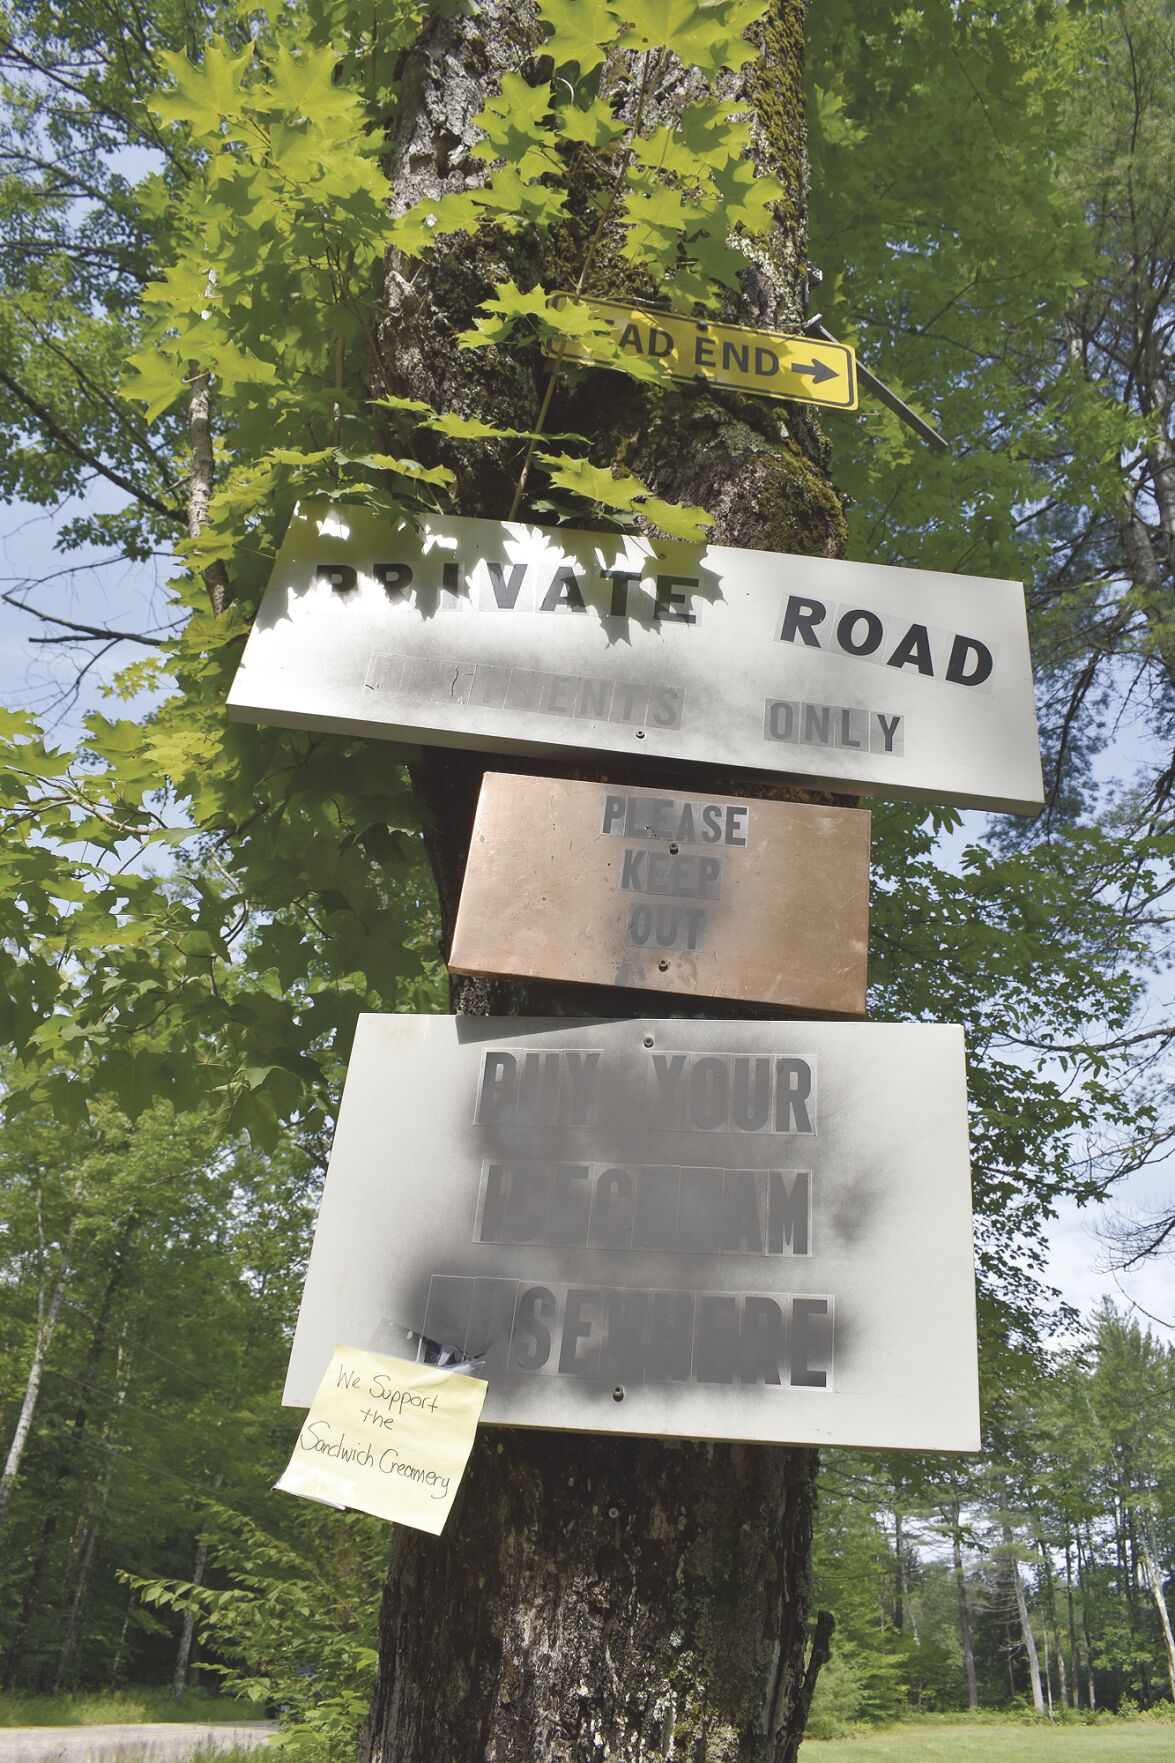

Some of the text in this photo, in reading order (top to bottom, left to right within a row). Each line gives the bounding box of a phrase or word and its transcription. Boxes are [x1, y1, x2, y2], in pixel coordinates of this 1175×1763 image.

[695, 336, 780, 376] END
[780, 595, 993, 687] ROAD
[769, 702, 901, 752] ONLY
[602, 795, 748, 846] PLEASE
[621, 850, 720, 900] KEEP
[630, 904, 706, 950] OUT
[650, 1054, 813, 1133] YOUR
[336, 1363, 439, 1415] We Support
[360, 1408, 395, 1431] the
[300, 1420, 450, 1500] Sandwich Creamery
